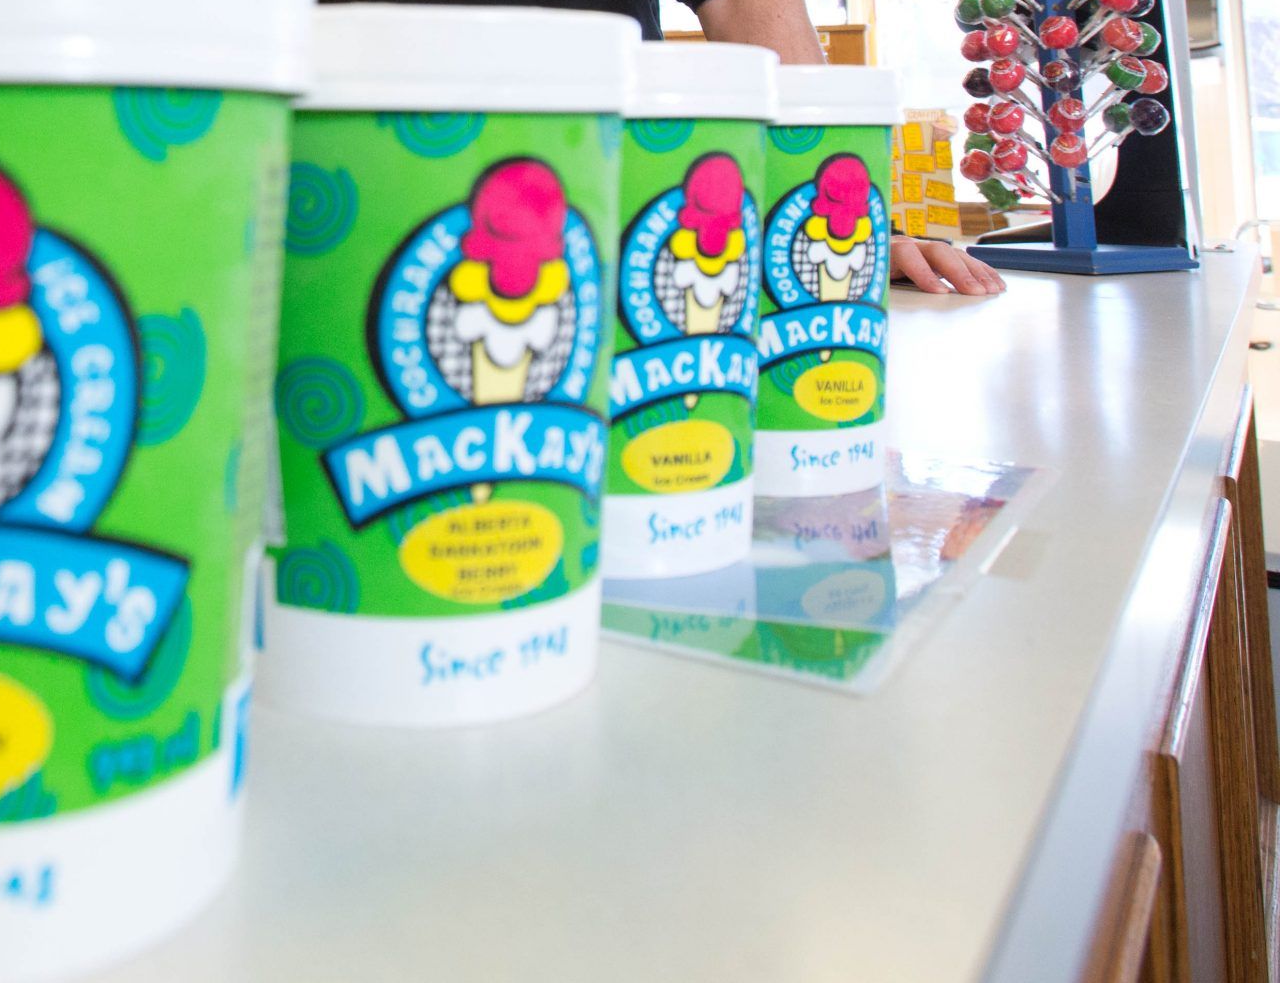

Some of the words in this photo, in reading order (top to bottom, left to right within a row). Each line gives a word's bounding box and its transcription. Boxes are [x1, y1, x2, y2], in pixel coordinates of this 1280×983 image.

[771, 193, 809, 304] COCHRANE
[629, 201, 676, 338] COCHRANE
[816, 380, 864, 392] VANILLA
[651, 451, 712, 468] VANILLA
[791, 444, 841, 472] Since
[647, 511, 706, 545] Since
